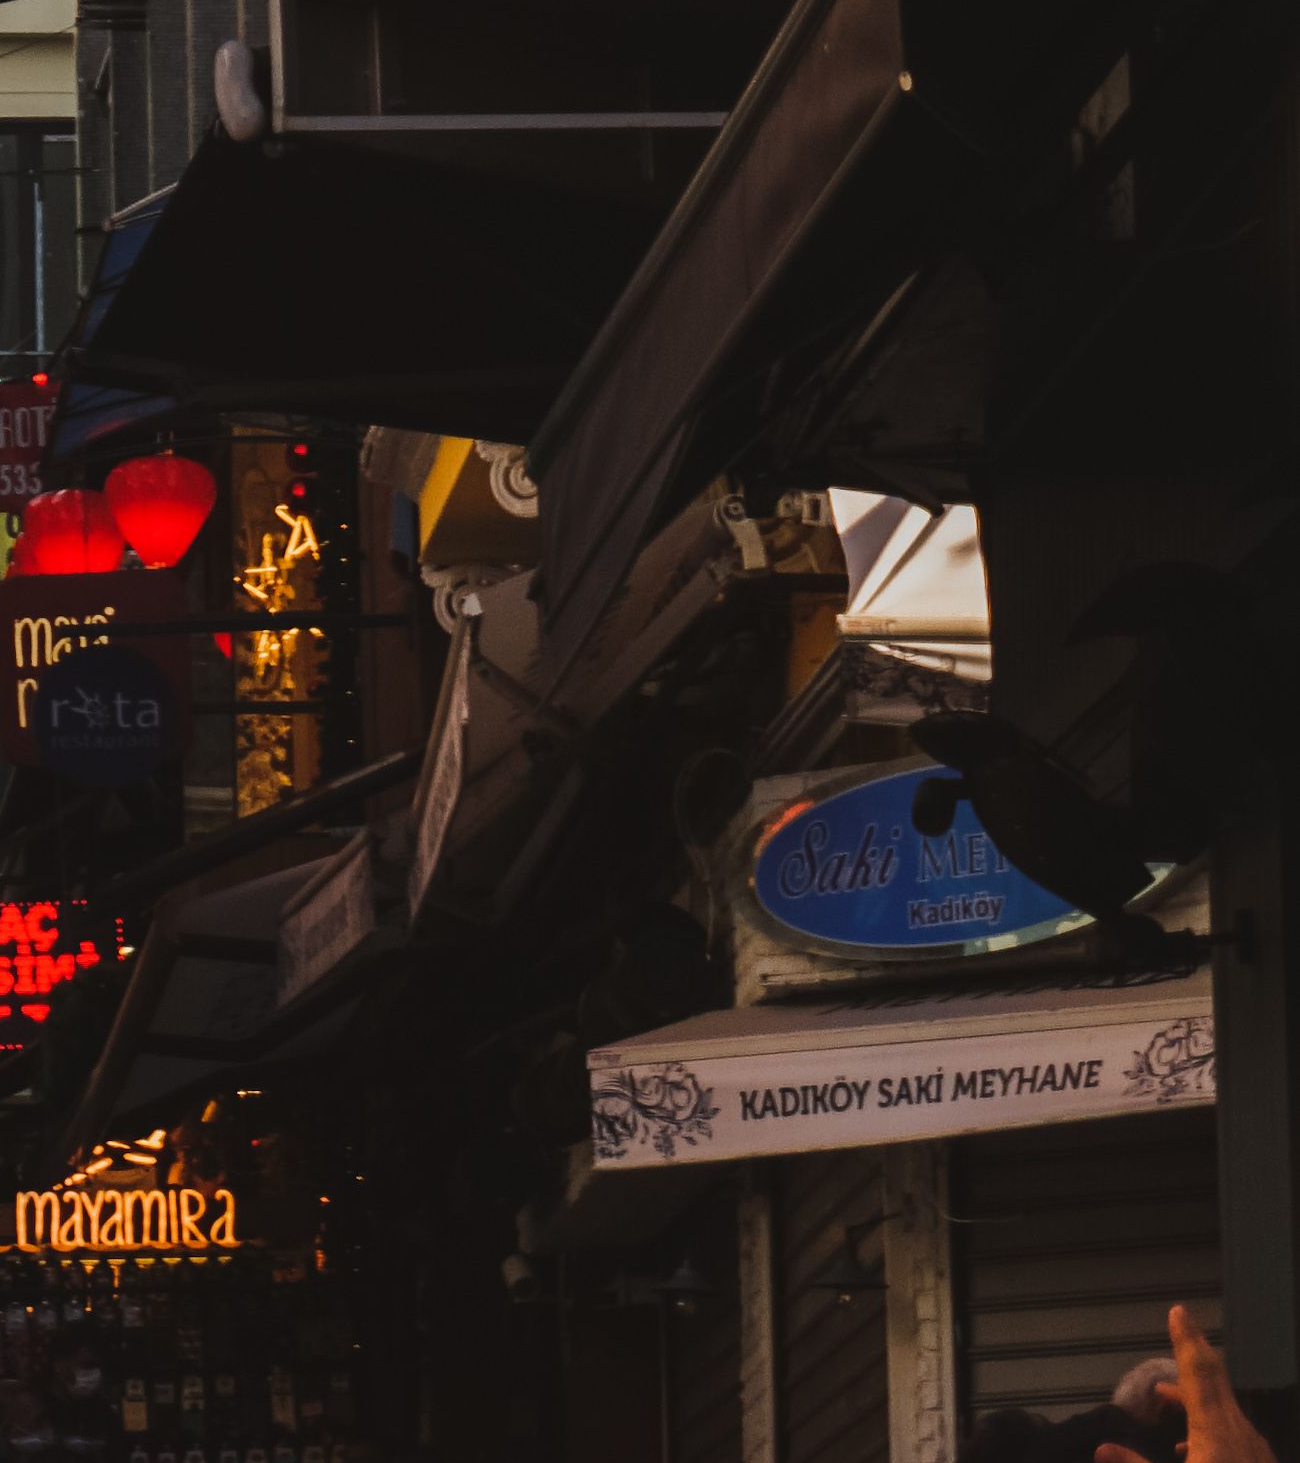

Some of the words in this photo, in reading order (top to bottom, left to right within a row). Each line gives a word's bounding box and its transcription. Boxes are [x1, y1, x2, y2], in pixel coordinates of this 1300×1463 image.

[779, 819, 903, 899] Saki
[739, 1075, 870, 1122] KADIKÖY
[877, 1066, 943, 1109] SAKİ
[950, 1059, 1104, 1102] MEYHANE
